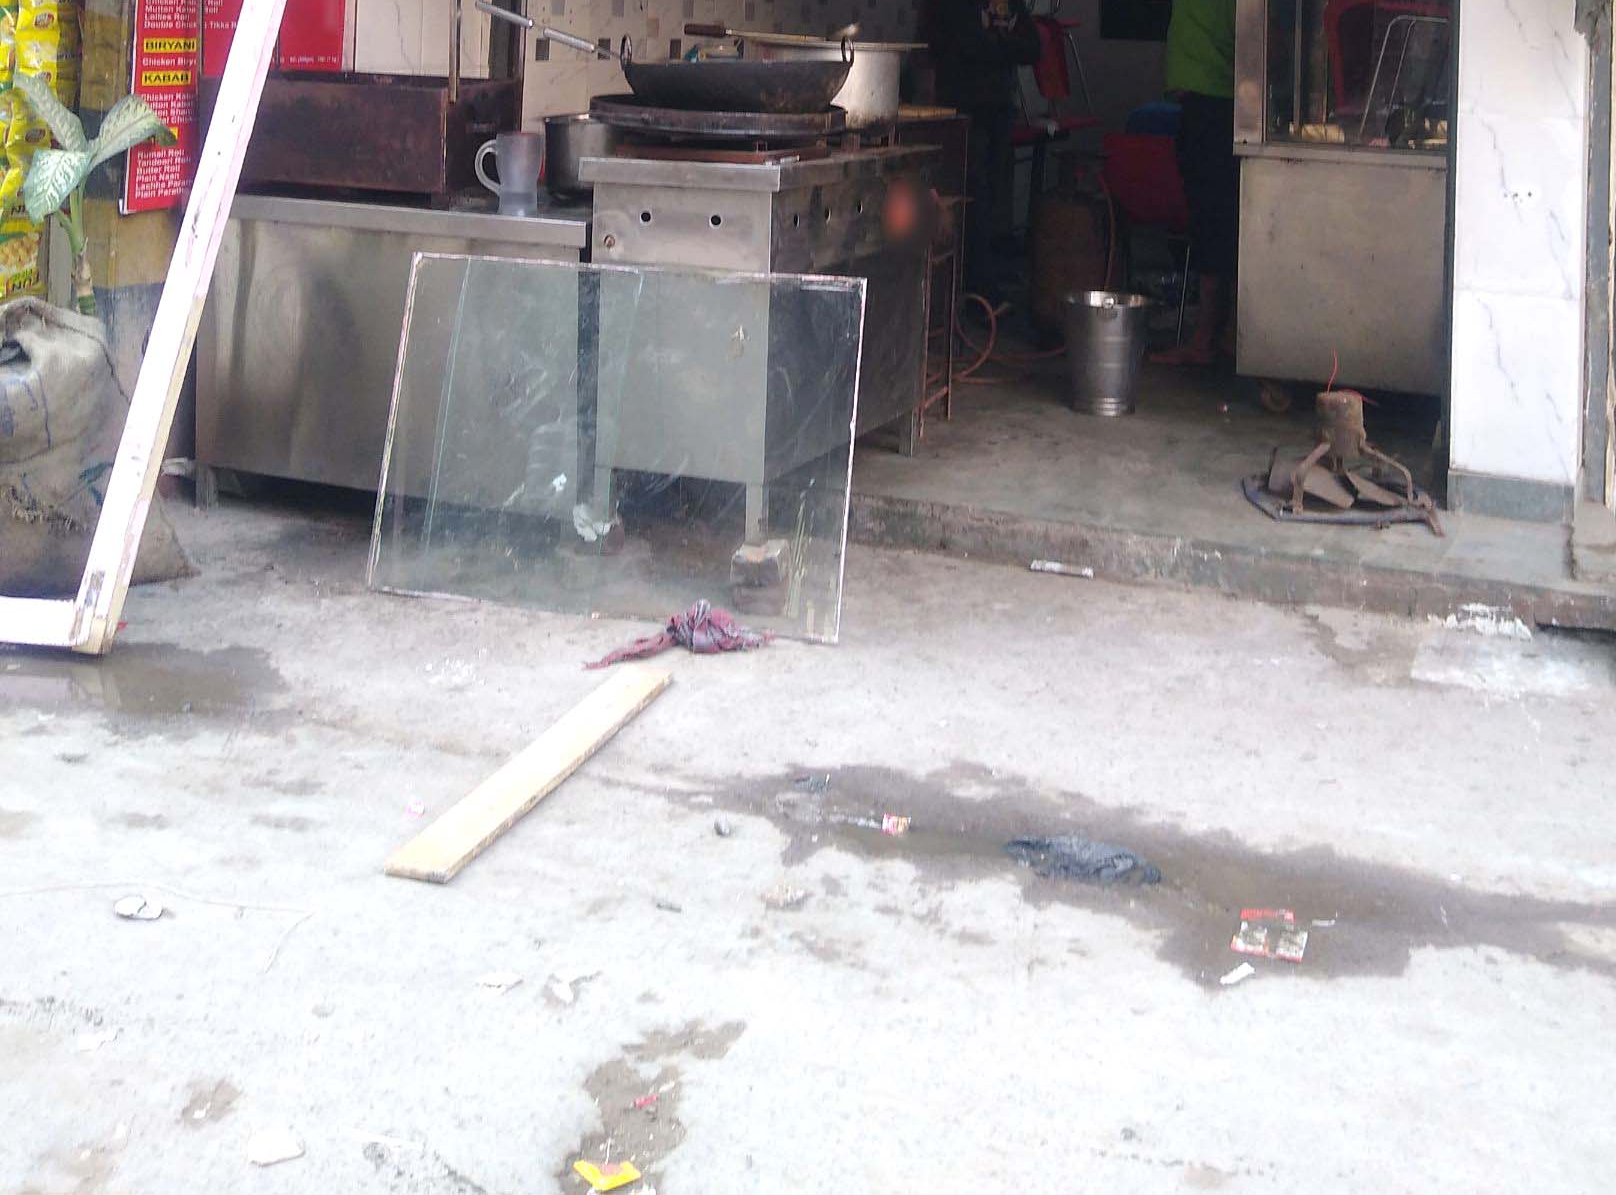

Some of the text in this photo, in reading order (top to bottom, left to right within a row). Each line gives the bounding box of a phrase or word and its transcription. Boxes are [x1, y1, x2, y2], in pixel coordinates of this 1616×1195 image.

[145, 40, 195, 50] BIRYANI
[142, 57, 176, 67] Chicken
[144, 73, 189, 83] KABAB
